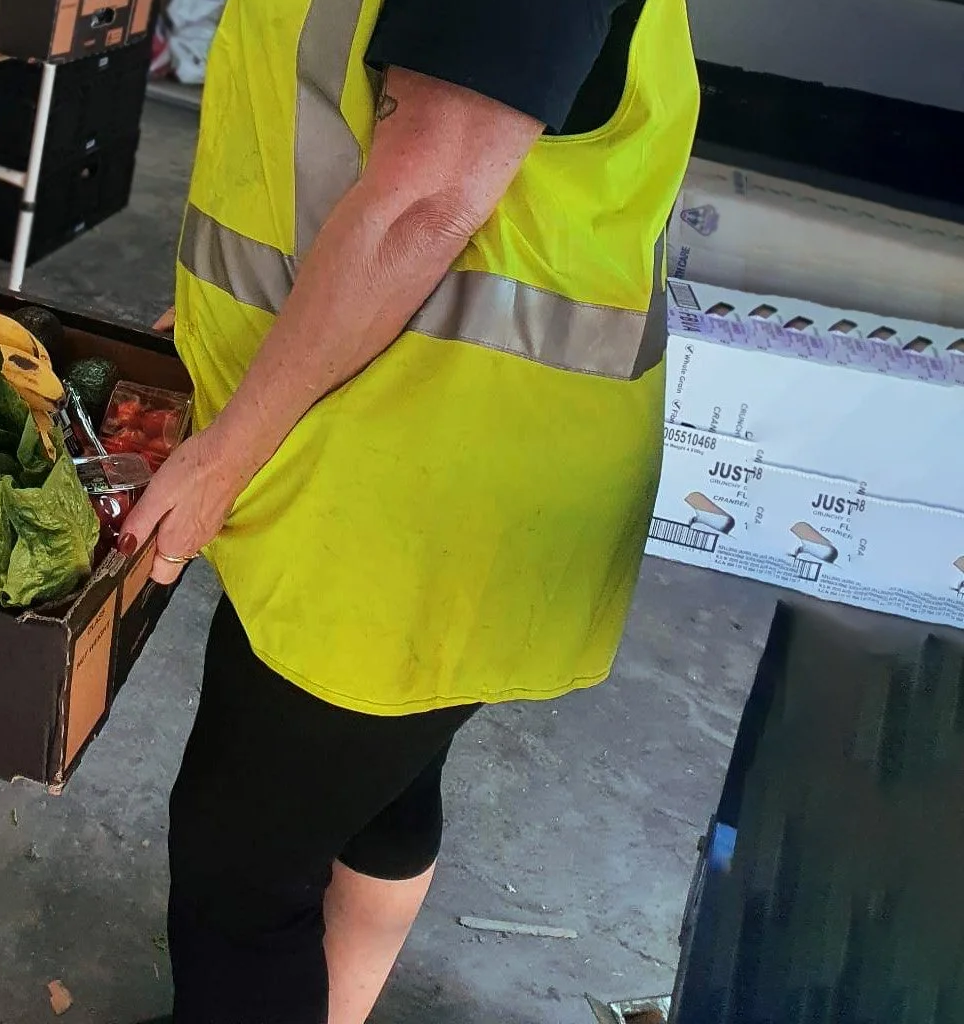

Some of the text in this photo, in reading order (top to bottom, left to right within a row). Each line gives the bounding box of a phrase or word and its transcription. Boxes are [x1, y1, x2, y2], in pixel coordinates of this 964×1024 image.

[676, 354, 692, 394] Whole Grain
[708, 461, 756, 484] JUST
[811, 493, 858, 516] JUST
